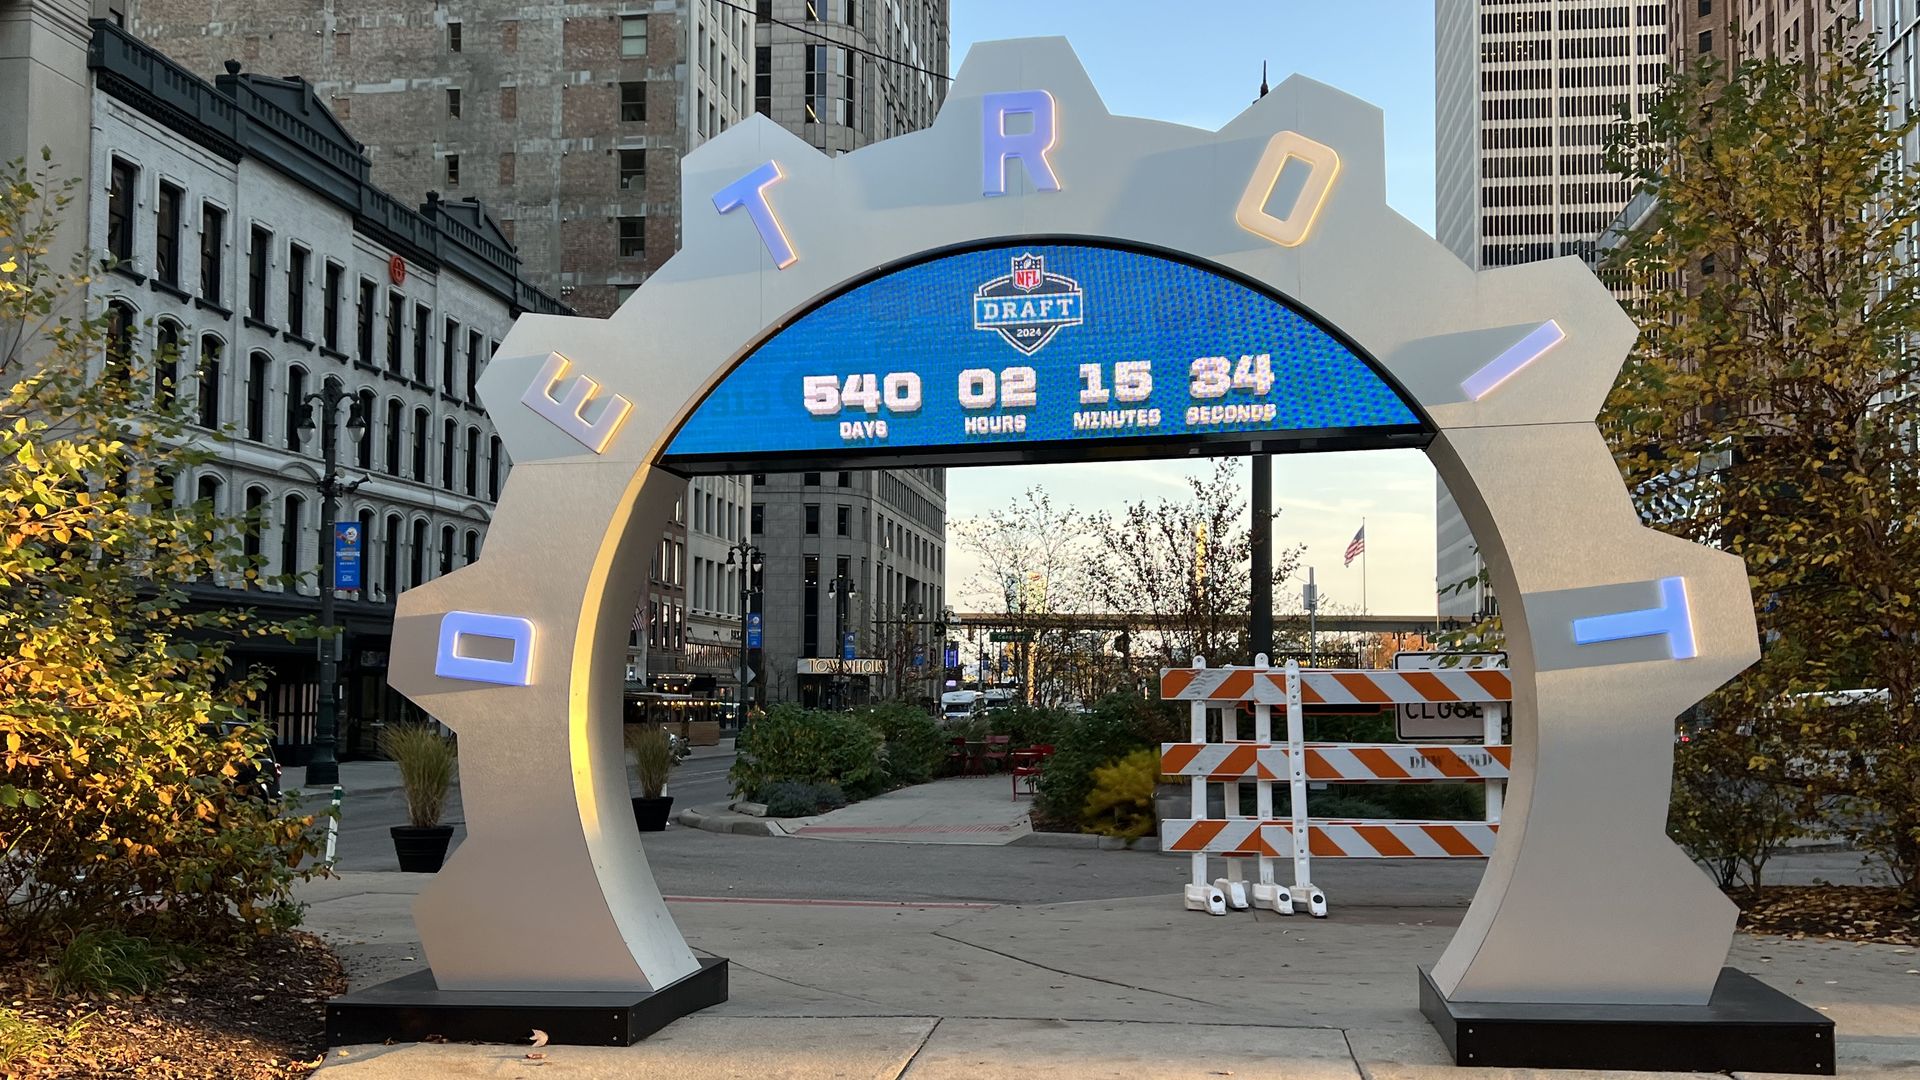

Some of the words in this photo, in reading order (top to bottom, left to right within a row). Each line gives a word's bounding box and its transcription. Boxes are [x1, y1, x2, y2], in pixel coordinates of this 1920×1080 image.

[1016, 270, 1040, 289] NFL
[983, 298, 1074, 320] DRAFT
[1016, 328, 1042, 337] 2024
[803, 372, 922, 415] 540
[958, 366, 1037, 409] 02
[1079, 360, 1153, 404] 15
[1189, 354, 1275, 398] 34
[839, 420, 889, 439] DAYS
[964, 415, 1026, 435] HOURS
[1073, 408, 1161, 430] MINUTES
[1186, 404, 1277, 425] SECONDS
